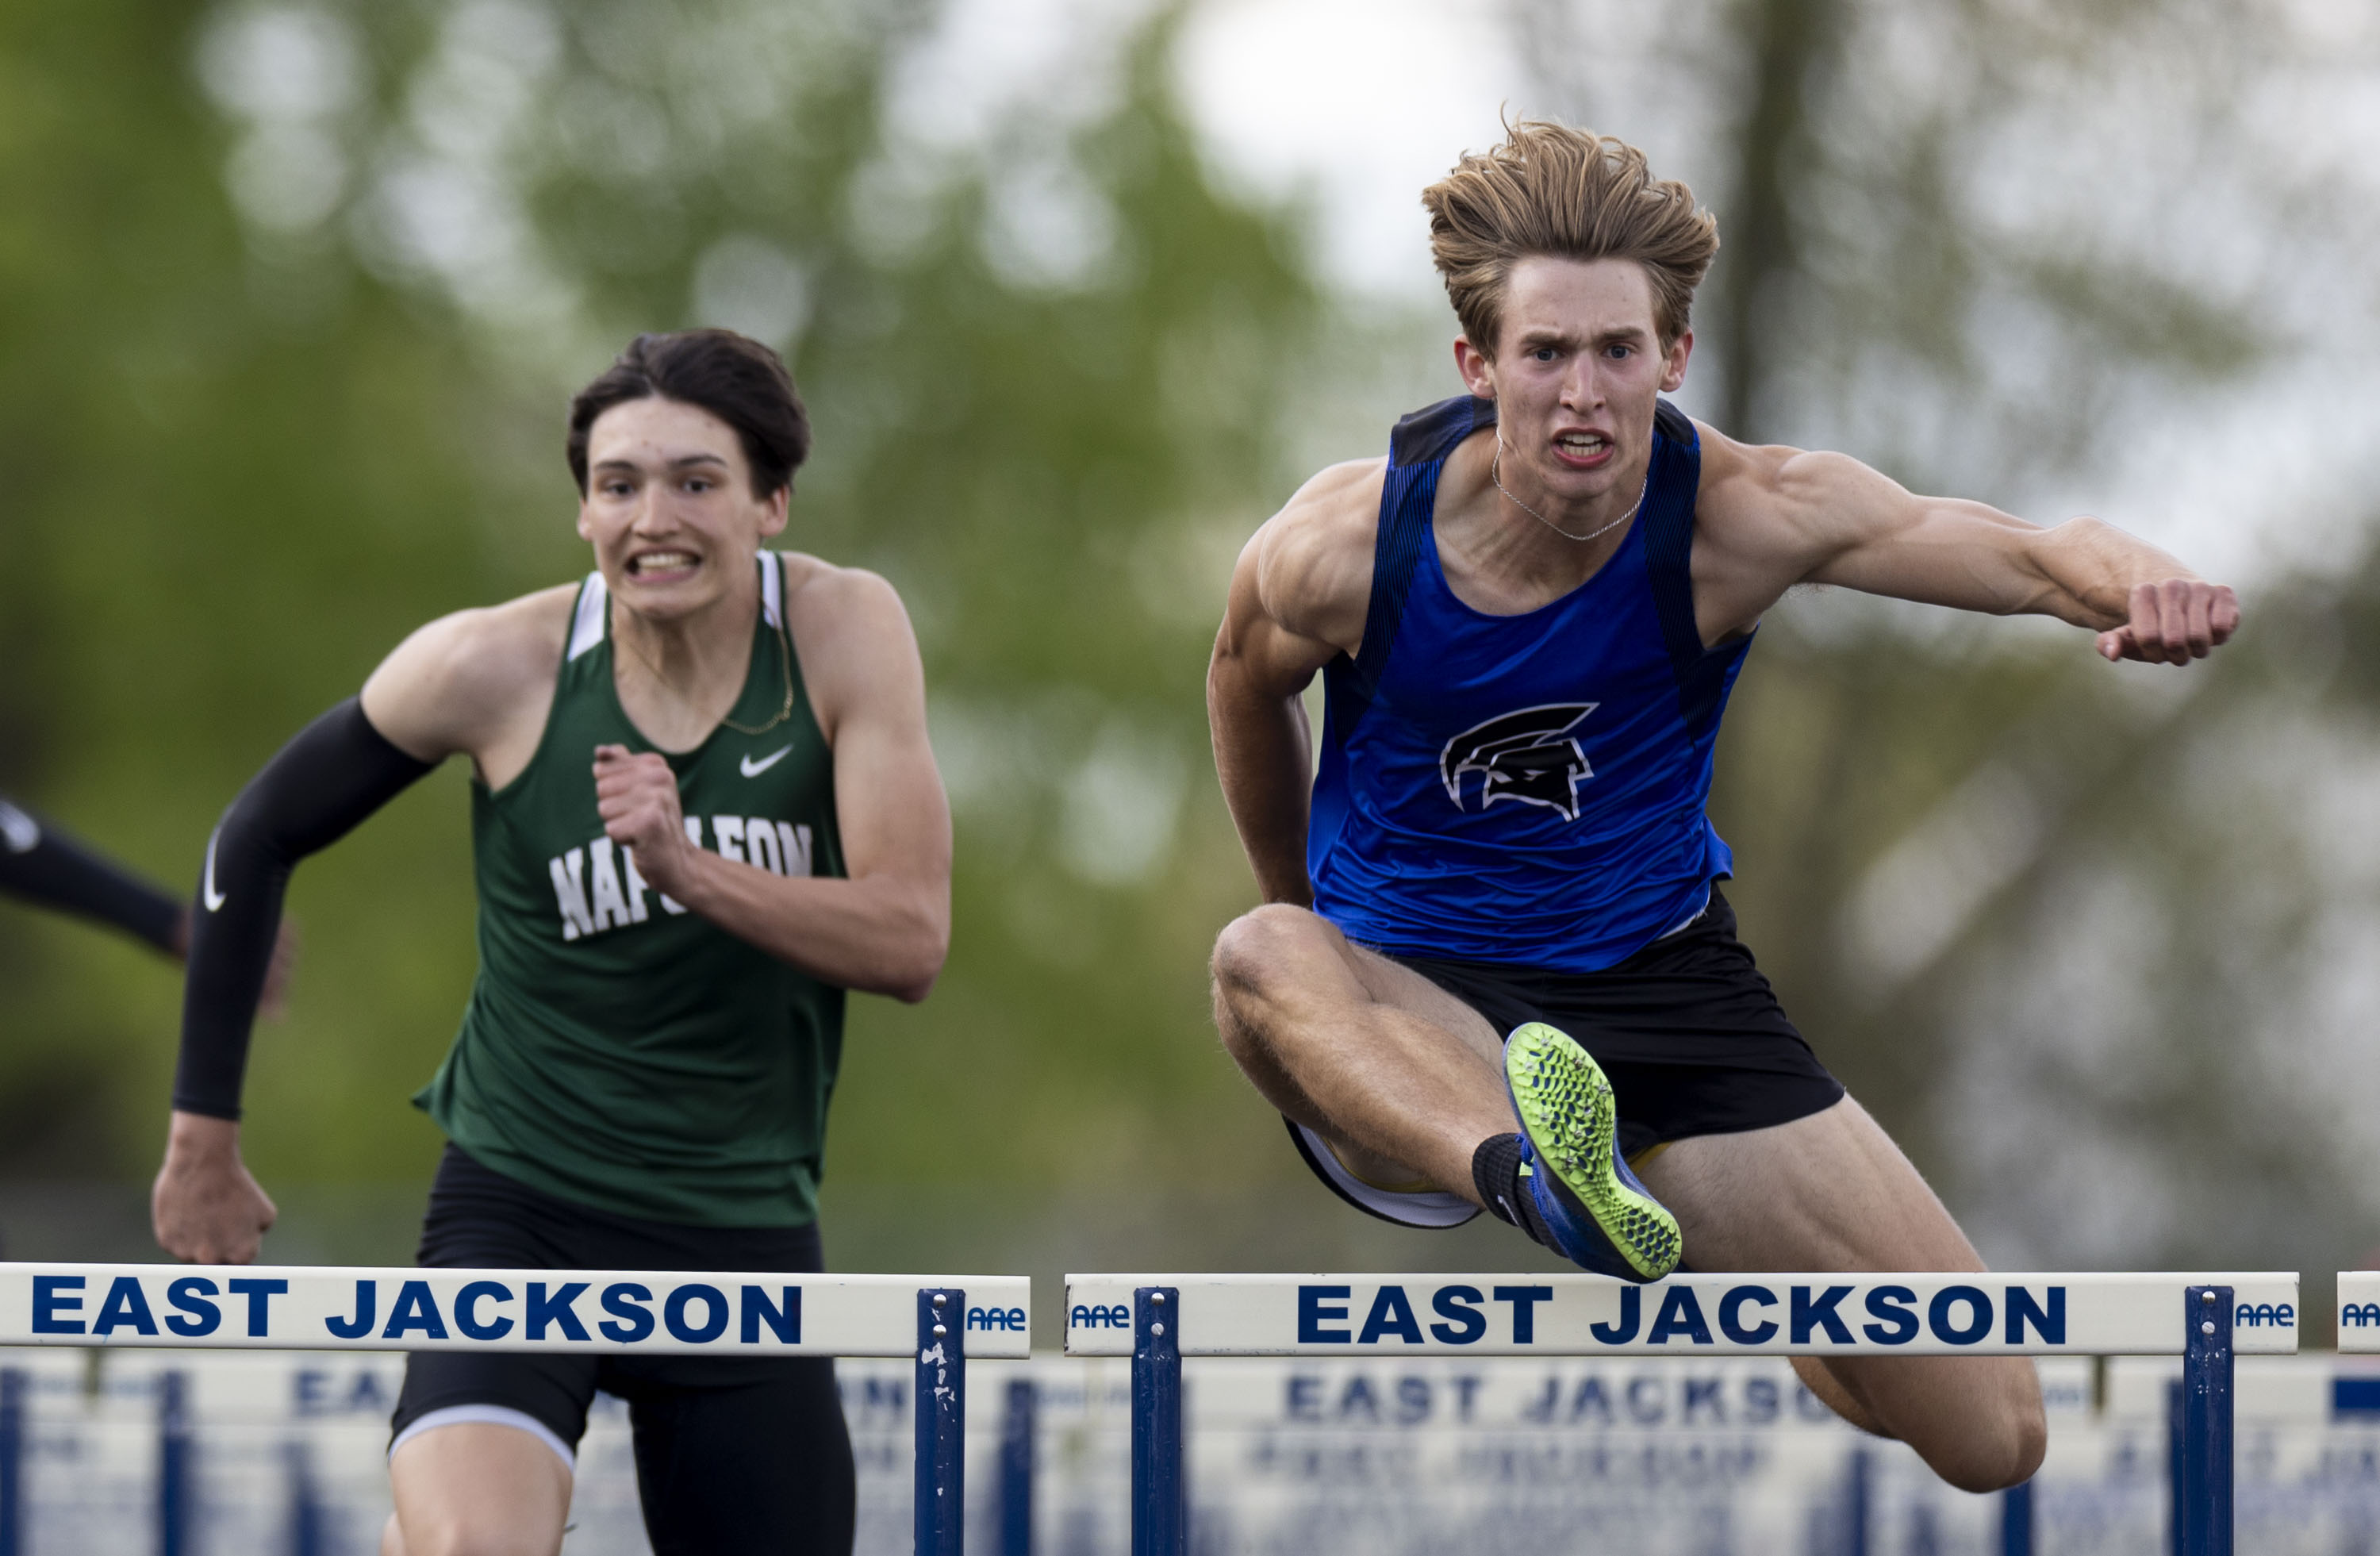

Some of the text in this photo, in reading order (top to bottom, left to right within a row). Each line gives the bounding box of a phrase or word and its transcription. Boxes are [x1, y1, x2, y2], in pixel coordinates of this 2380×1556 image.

[32, 1275, 802, 1345] EAST JACKSON
[1298, 1285, 2066, 1346] EAST JACKSON
[1284, 1374, 1484, 1423] EAST
